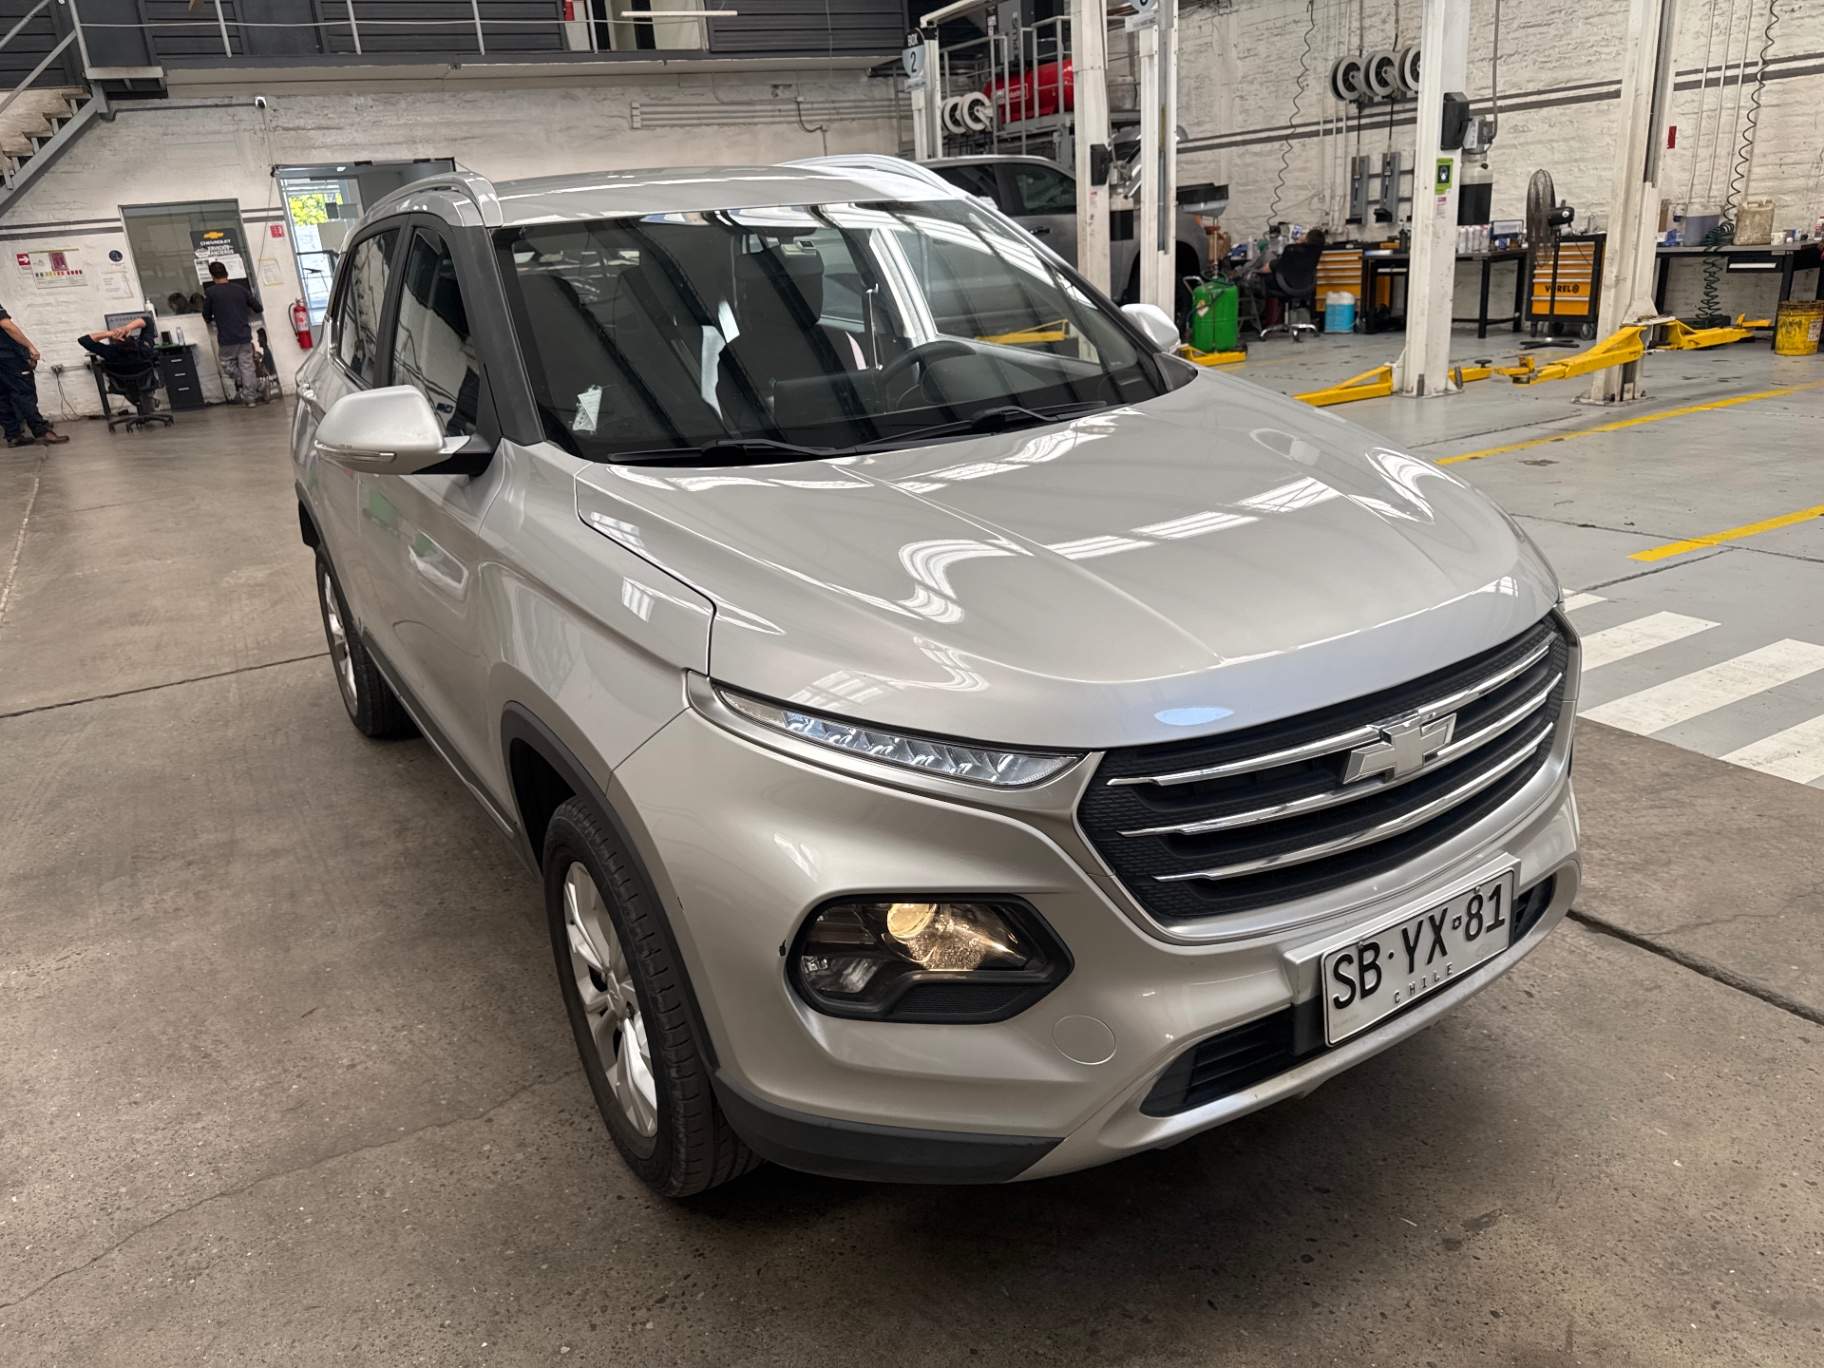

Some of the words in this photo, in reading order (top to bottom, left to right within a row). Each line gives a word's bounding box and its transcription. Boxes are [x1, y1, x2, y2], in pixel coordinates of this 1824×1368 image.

[907, 33, 918, 47] BOX
[910, 51, 917, 73] 2
[1394, 961, 1453, 1004] CHILE
